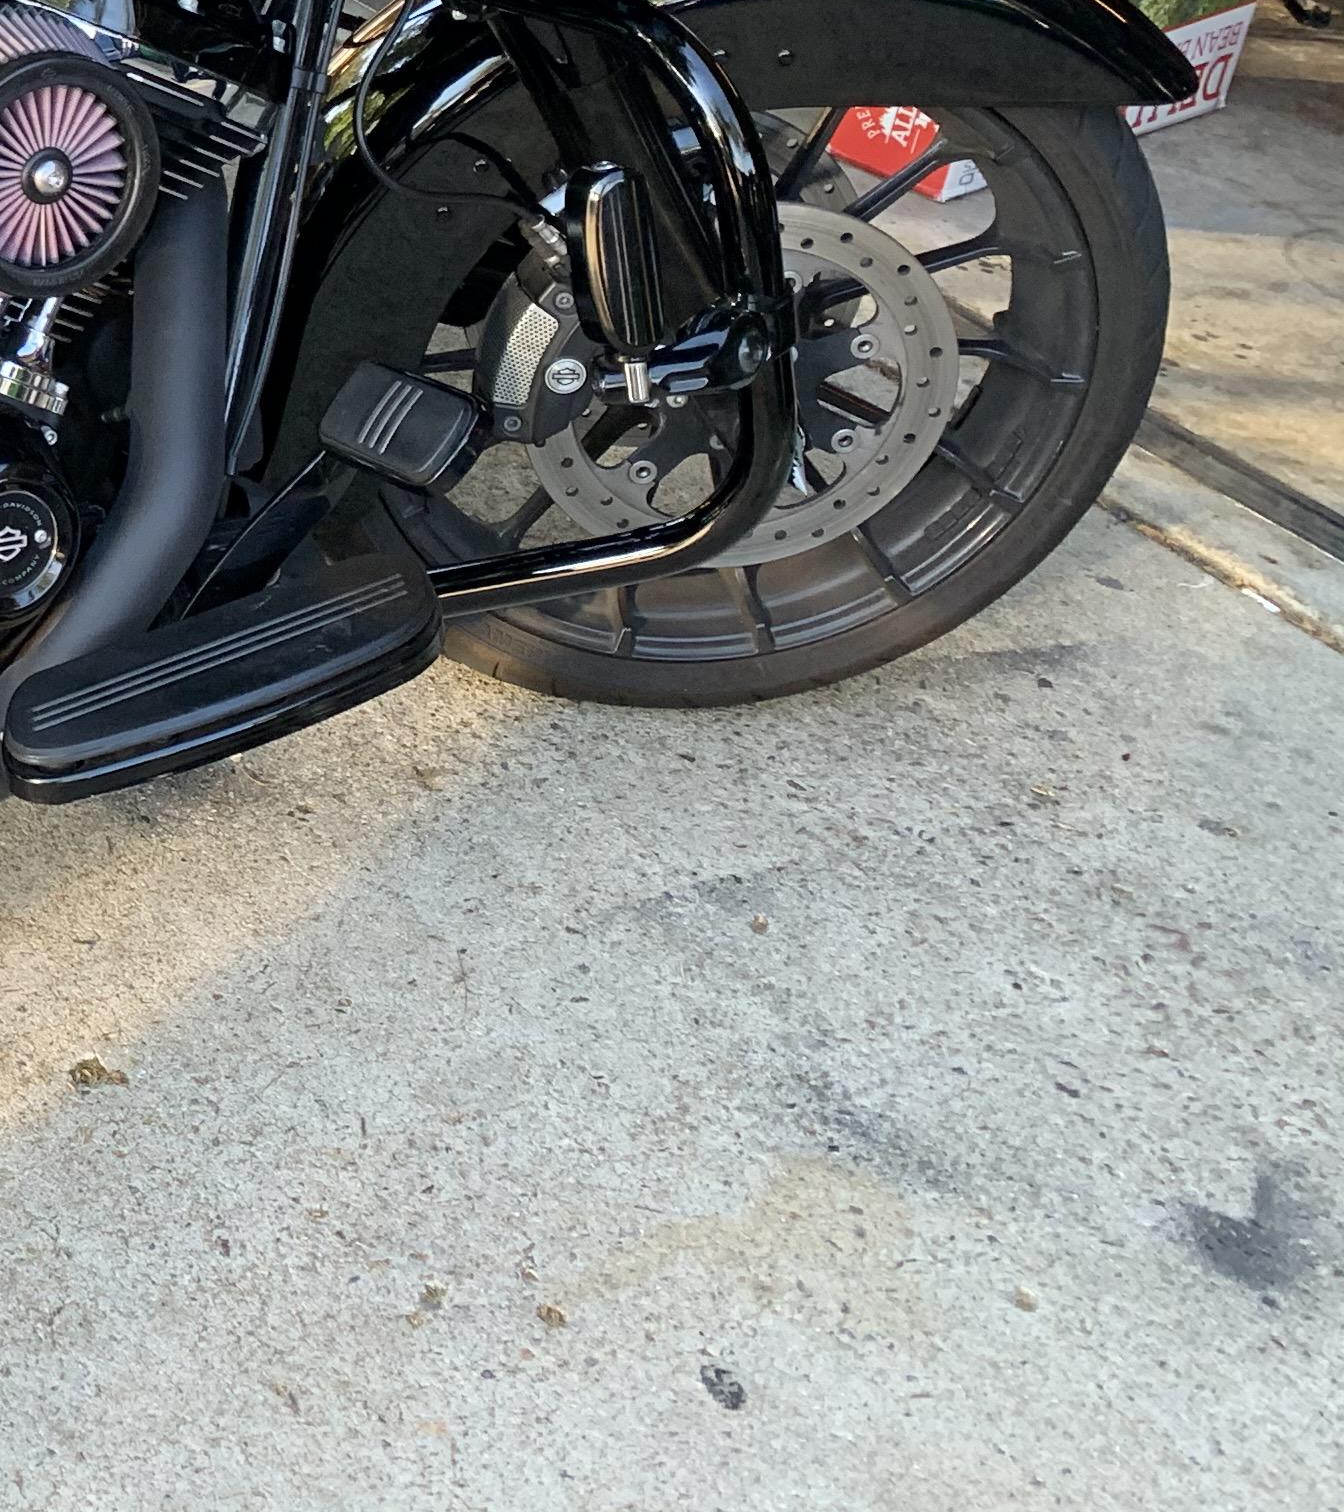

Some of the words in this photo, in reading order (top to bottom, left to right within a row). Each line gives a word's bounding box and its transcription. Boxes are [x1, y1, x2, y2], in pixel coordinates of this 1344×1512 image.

[1190, 21, 1244, 60] BEAN
[853, 106, 881, 140] PRE
[891, 106, 919, 148] ALL
[1, 553, 40, 586] COMPANY
